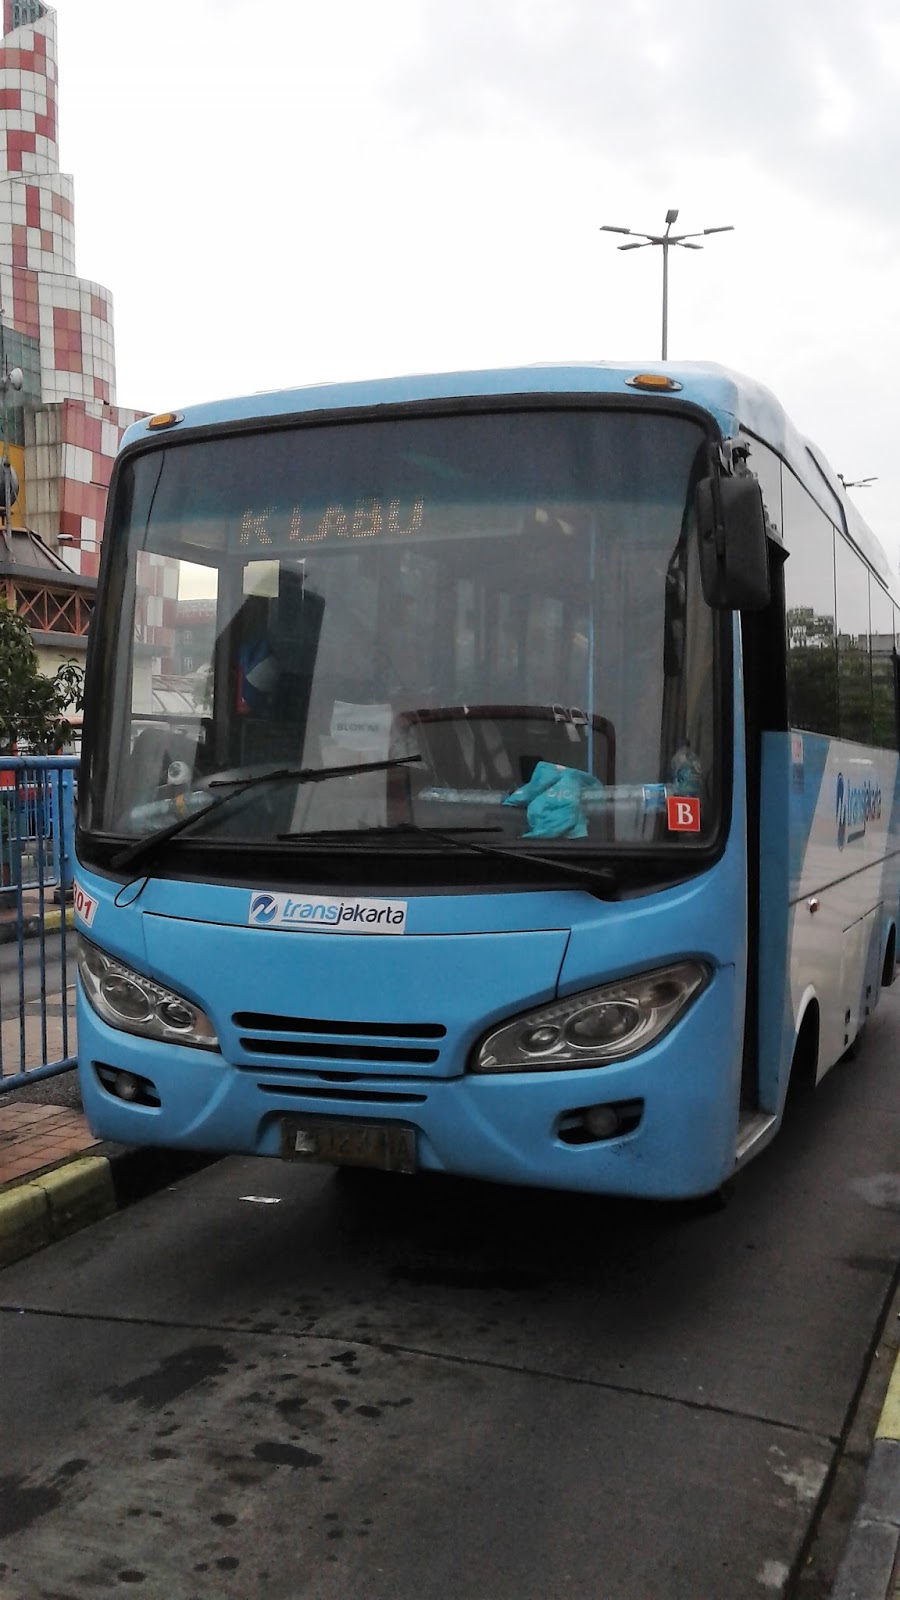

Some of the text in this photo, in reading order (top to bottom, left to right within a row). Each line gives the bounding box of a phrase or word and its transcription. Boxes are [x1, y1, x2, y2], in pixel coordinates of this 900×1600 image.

[240, 495, 425, 544] K LABU
[676, 802, 694, 825] B
[282, 898, 405, 925] transjakarta
